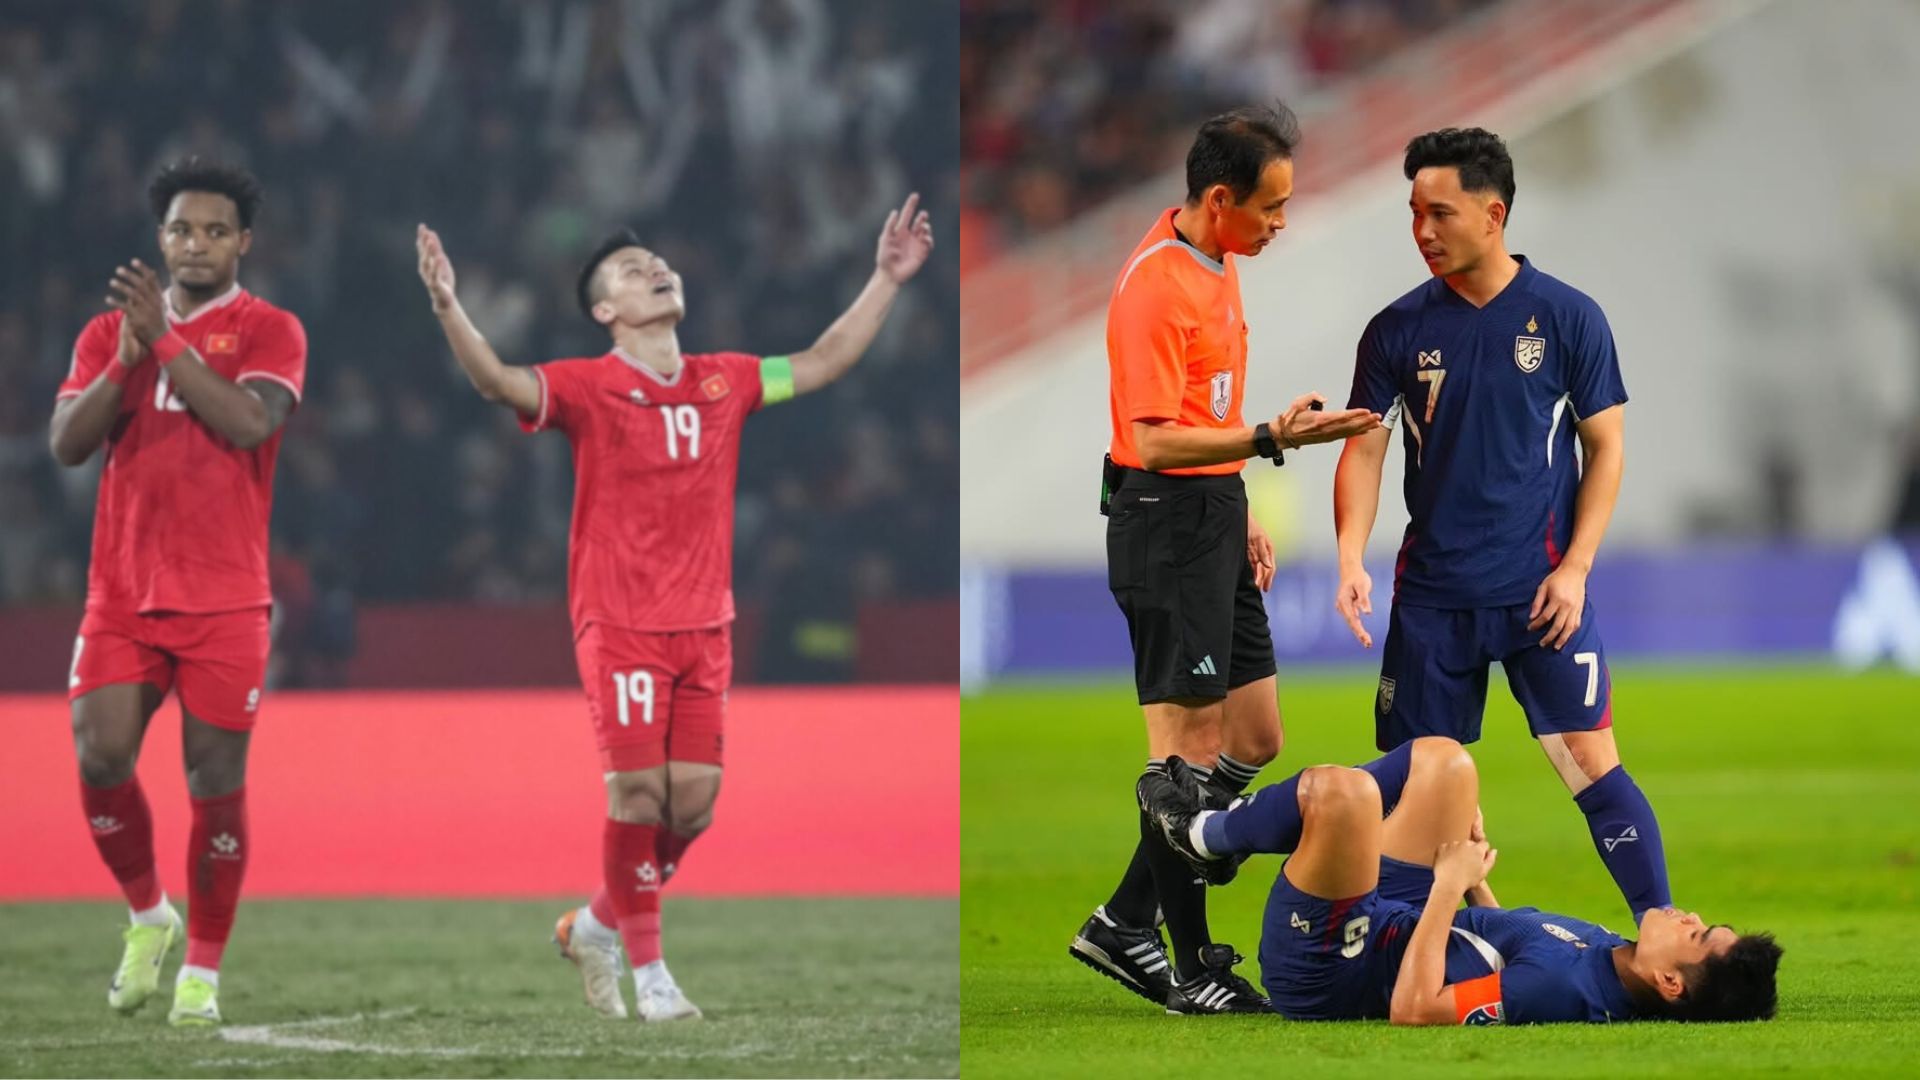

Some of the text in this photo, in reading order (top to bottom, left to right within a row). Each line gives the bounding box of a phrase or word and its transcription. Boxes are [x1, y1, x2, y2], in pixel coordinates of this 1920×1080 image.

[1417, 369, 1447, 423] 7
[659, 404, 702, 460] 19
[611, 669, 655, 727] 19
[1574, 652, 1599, 707] 7
